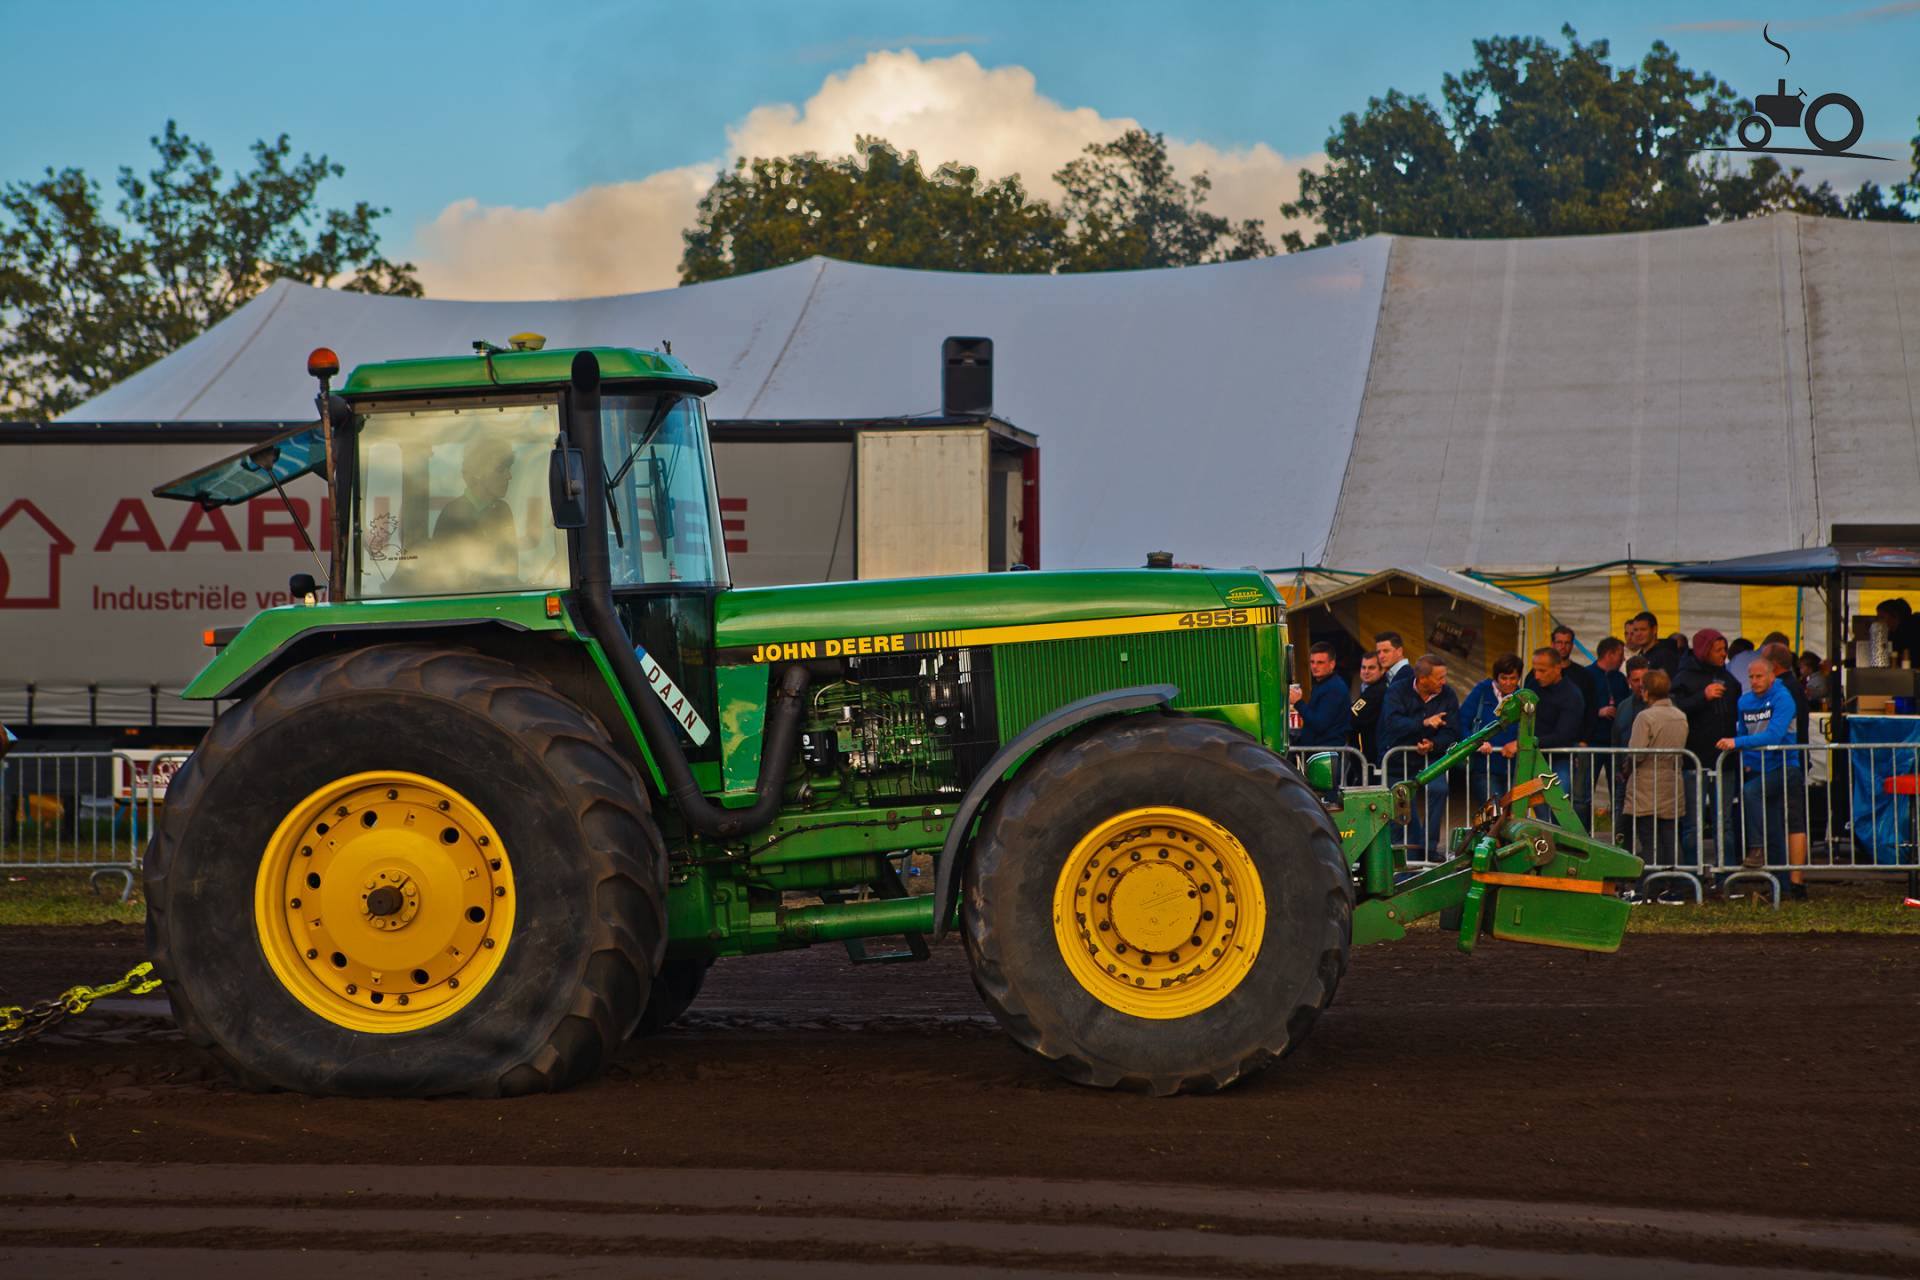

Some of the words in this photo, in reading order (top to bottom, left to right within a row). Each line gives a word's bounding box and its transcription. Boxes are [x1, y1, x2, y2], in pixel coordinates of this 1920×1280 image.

[92, 585, 248, 611] Industriële
[1178, 609, 1249, 628] 4955
[752, 641, 816, 663] JOHN
[825, 634, 905, 657] DEERE
[647, 665, 698, 730] DAAN
